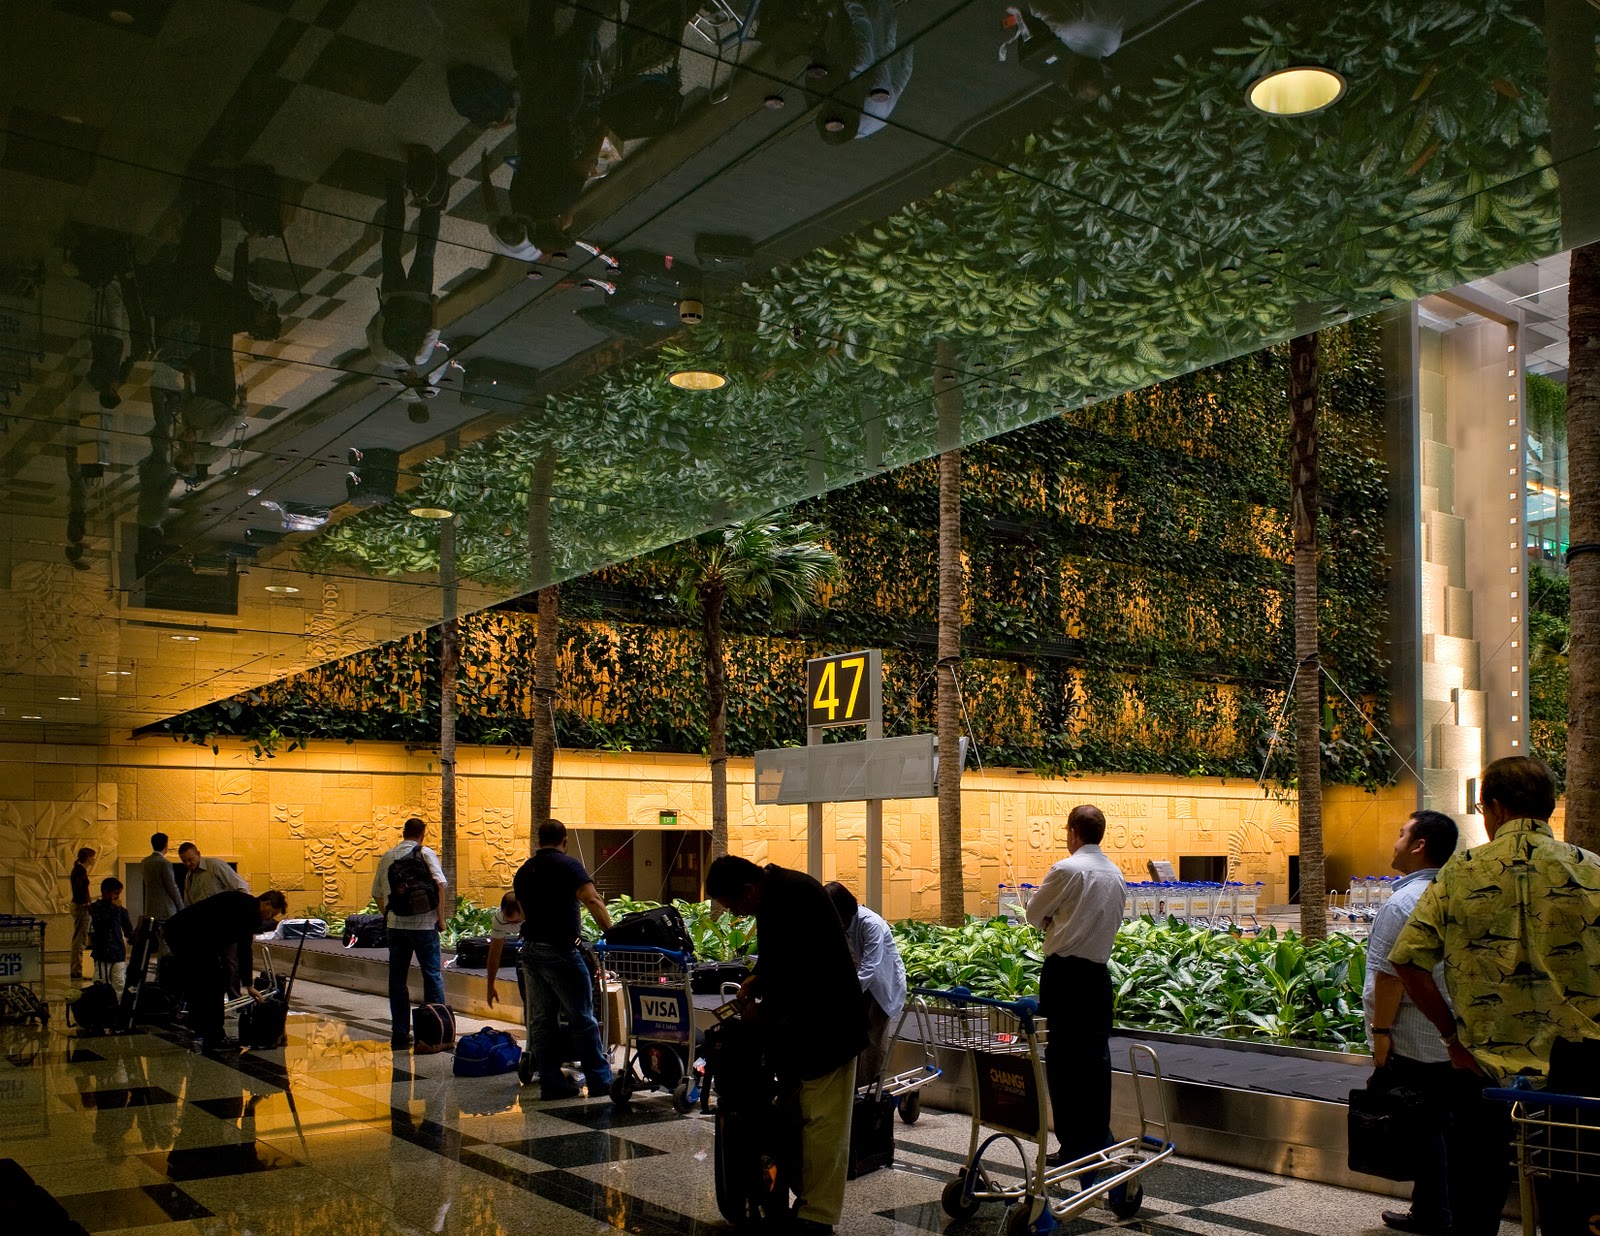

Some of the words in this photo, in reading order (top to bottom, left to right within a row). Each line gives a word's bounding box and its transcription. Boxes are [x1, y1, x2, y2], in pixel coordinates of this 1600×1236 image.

[813, 657, 865, 720] 47
[1028, 799, 1087, 816] MALIGAY
[644, 1001, 677, 1018] VISA
